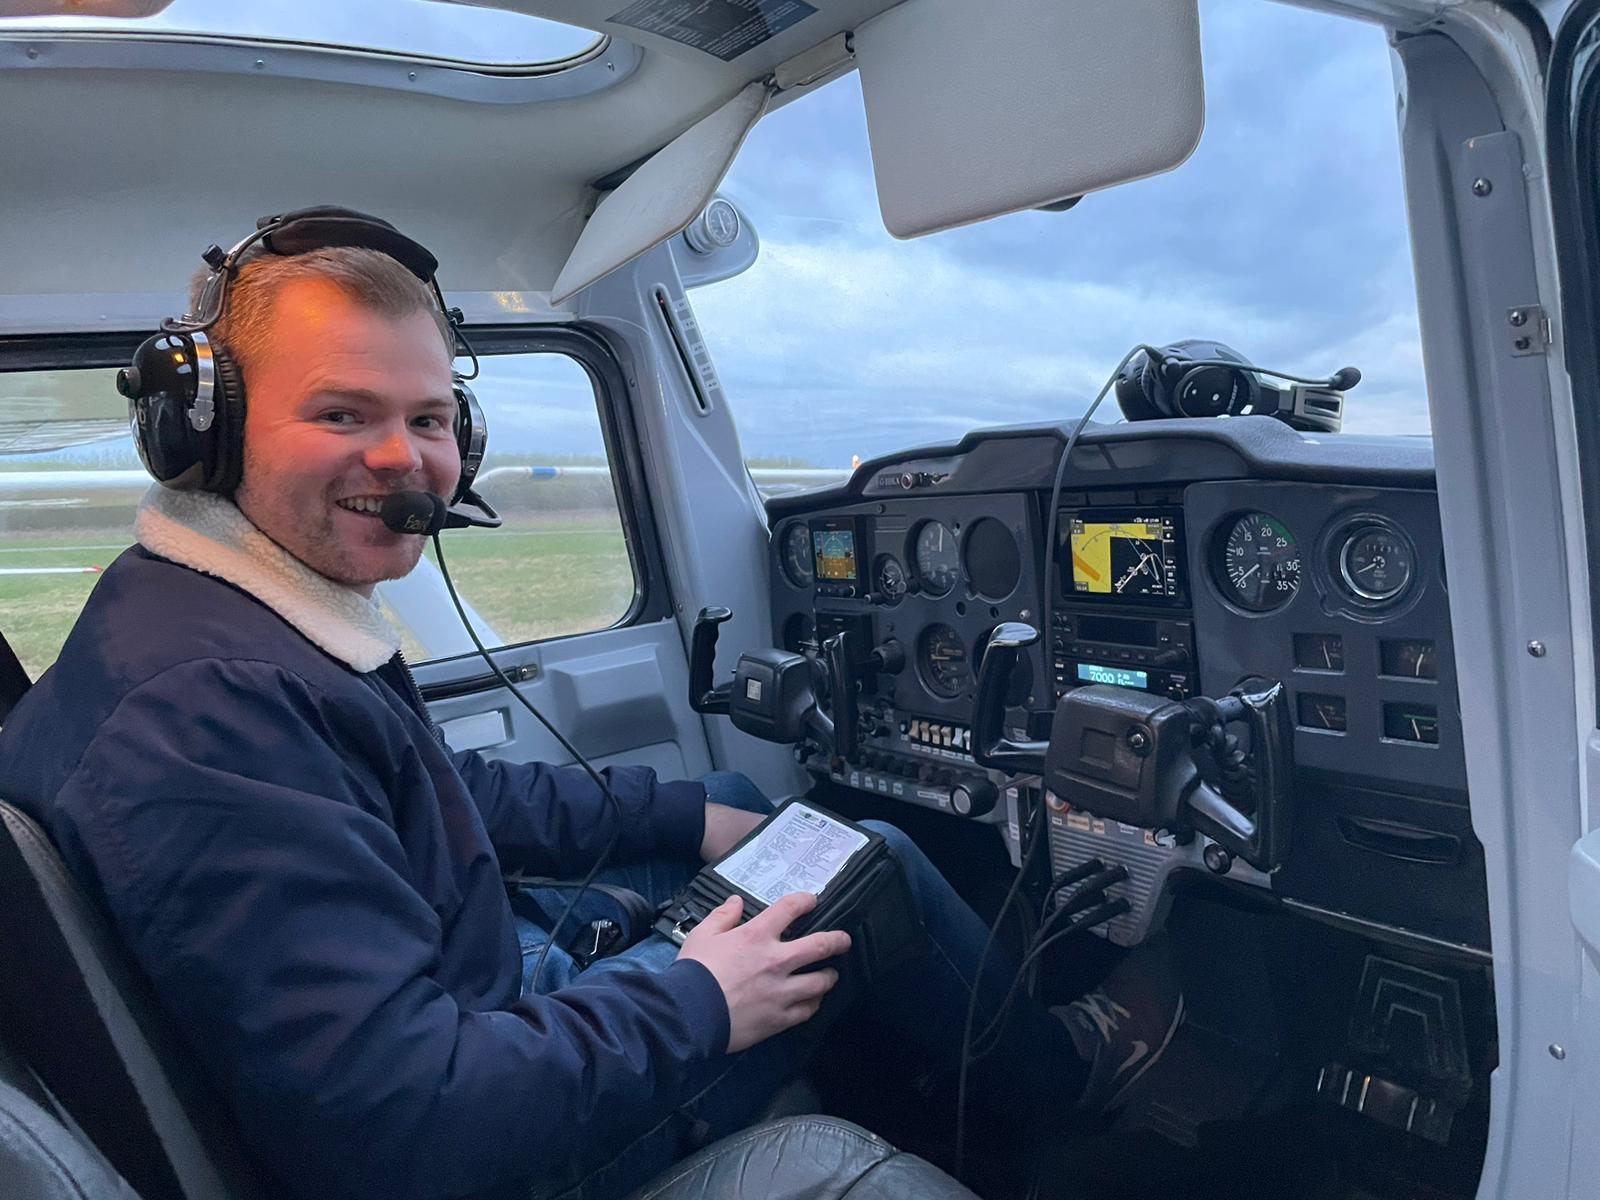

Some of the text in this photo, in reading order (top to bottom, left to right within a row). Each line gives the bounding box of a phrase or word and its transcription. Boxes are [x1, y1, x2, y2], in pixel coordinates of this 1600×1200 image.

[1244, 531, 1252, 541] 15
[1261, 527, 1272, 537] 20
[1276, 537, 1288, 547] 25
[1235, 547, 1244, 556] 10
[1238, 566, 1244, 576] 5
[1286, 561, 1298, 571] 30
[1276, 581, 1288, 591] 35
[1089, 671, 1115, 684] 7000
